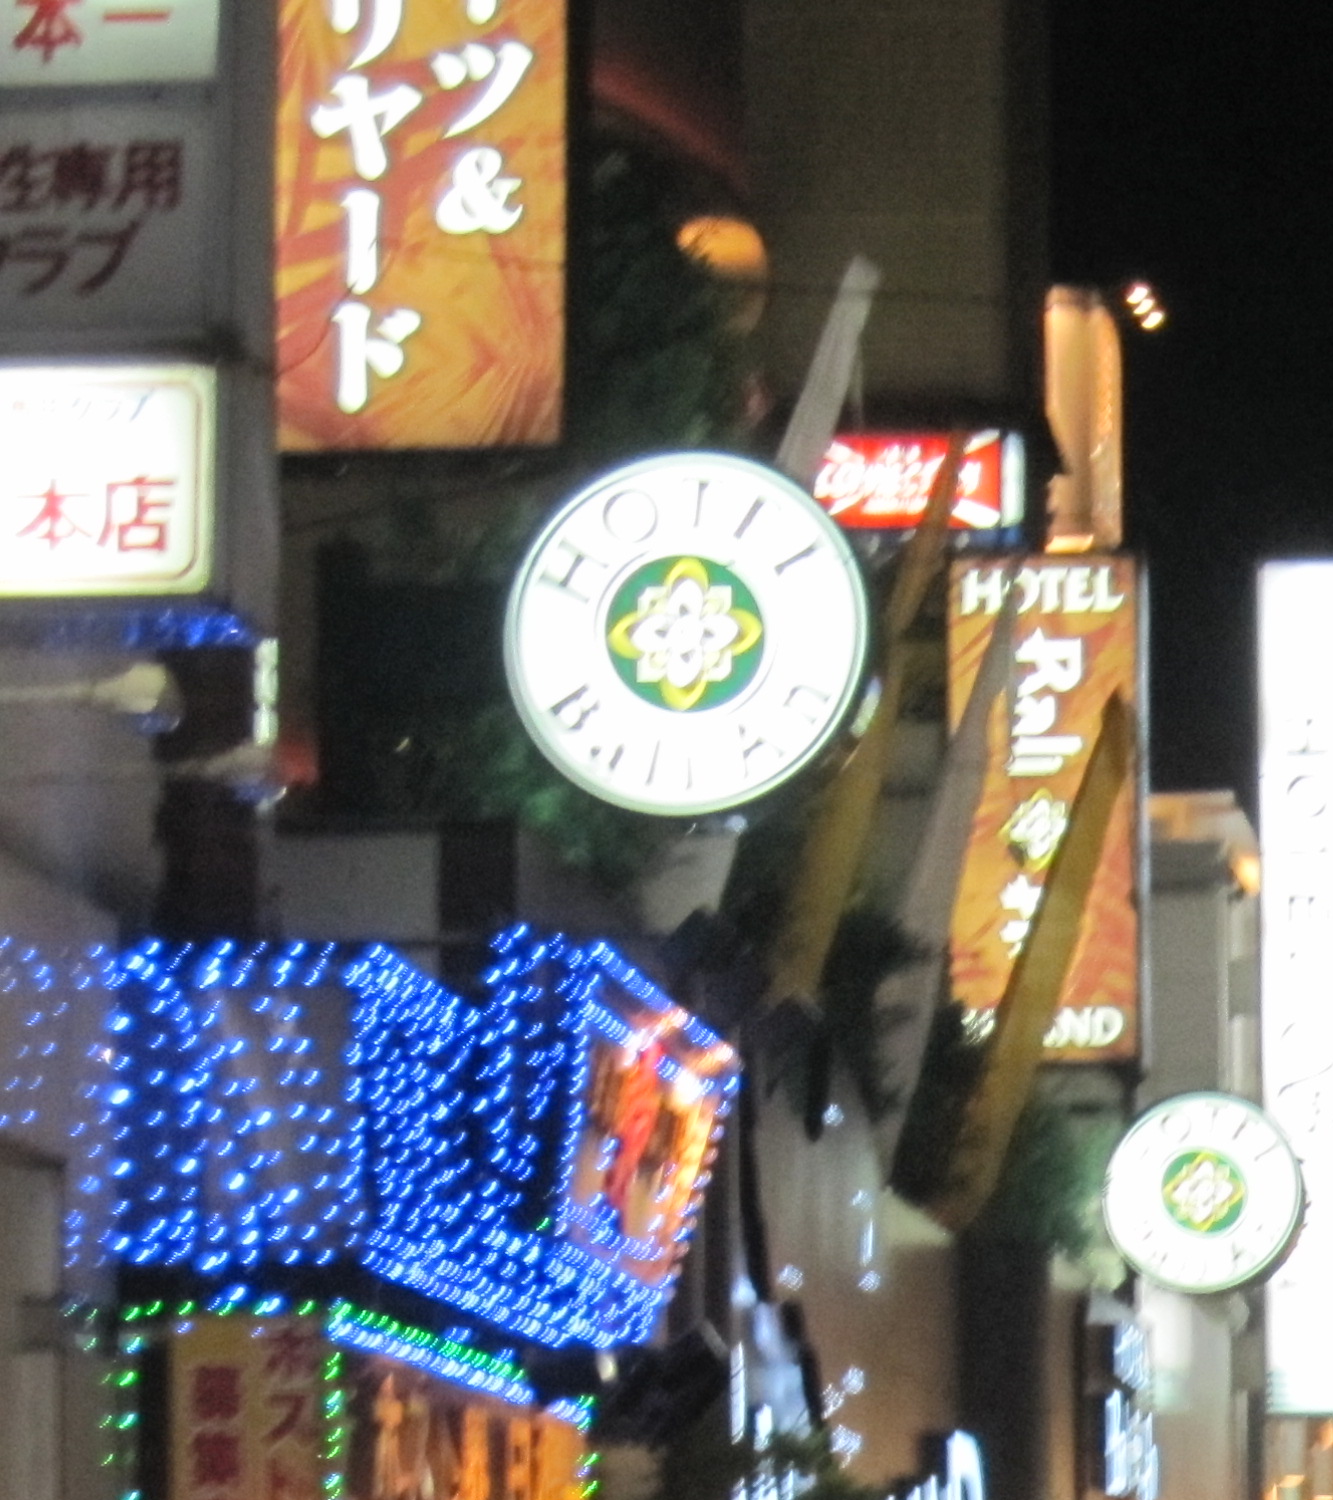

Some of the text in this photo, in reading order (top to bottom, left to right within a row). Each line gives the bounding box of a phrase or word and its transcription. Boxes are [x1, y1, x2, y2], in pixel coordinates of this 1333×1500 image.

[430, 0, 533, 234] ツ&
[15, 475, 177, 553] 本店
[961, 564, 1126, 617] HOTEL
